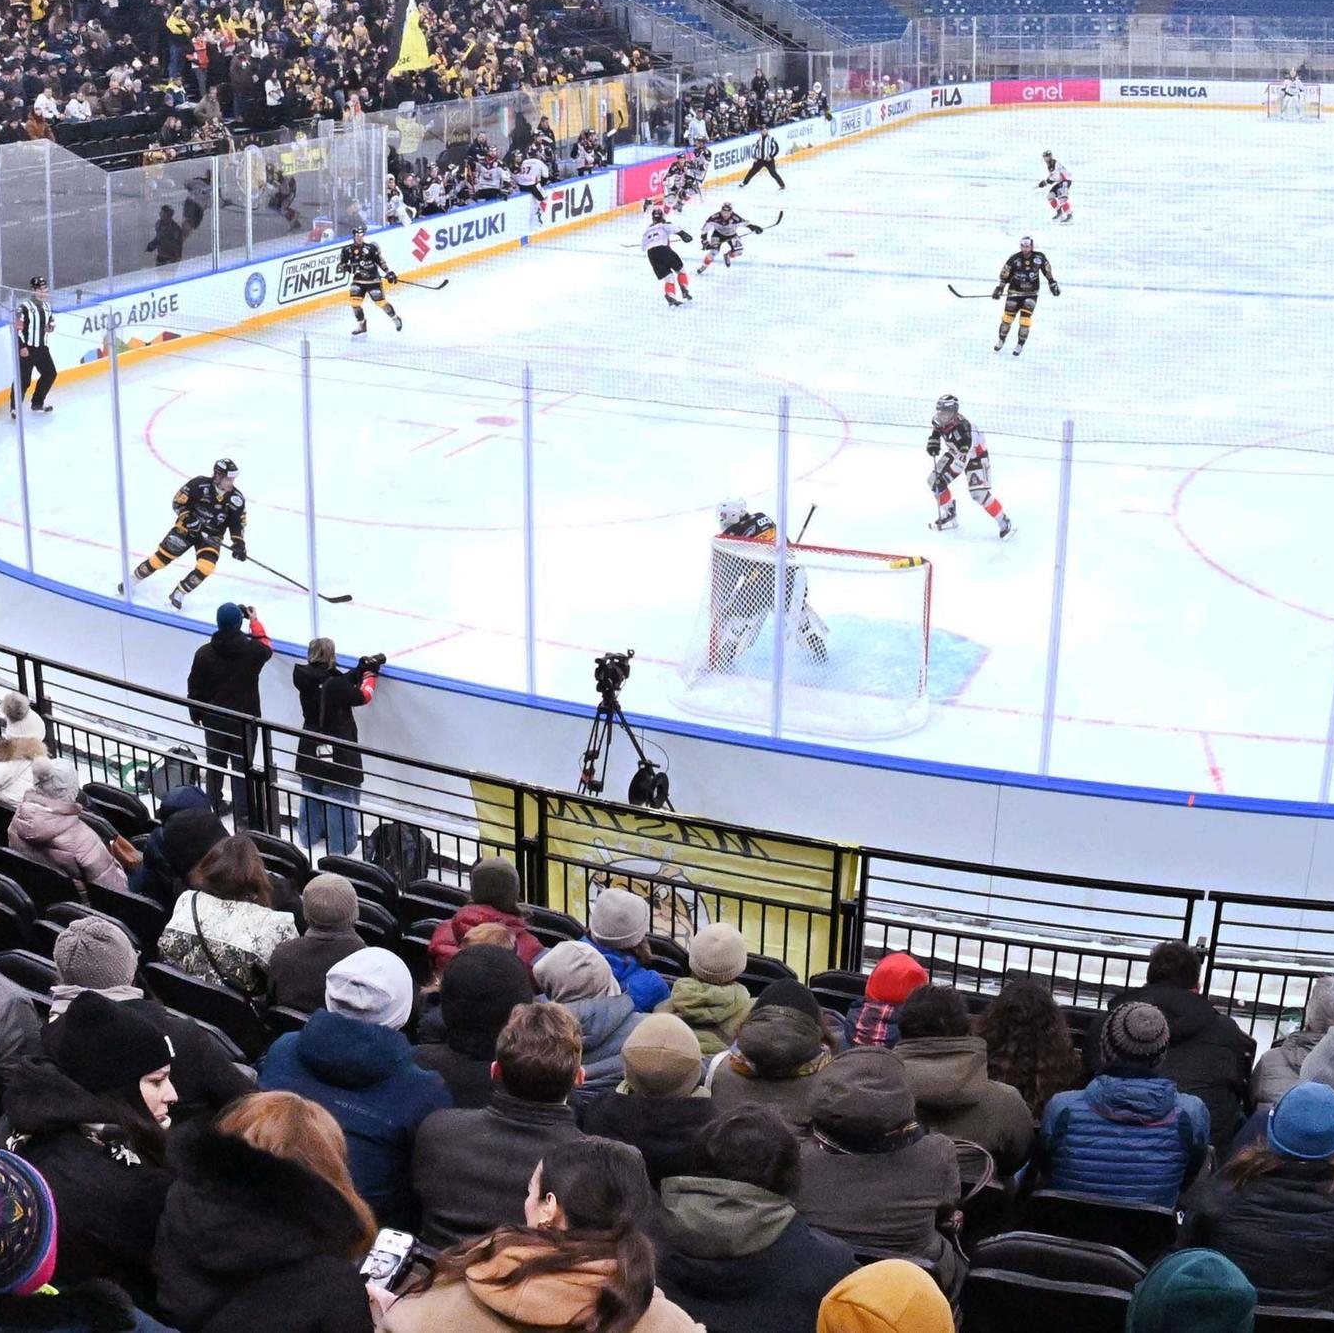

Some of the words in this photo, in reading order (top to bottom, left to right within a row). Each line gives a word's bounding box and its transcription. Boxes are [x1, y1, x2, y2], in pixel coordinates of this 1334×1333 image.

[931, 87, 962, 108] FILA
[1022, 82, 1064, 100] enel
[1120, 85, 1208, 98] ESSELUNGA
[888, 99, 912, 116] SUZUKI
[714, 139, 760, 170] ESSELUNG
[551, 183, 594, 223] FILA
[435, 212, 506, 251] SUZUKI
[286, 260, 317, 275] MILANO
[283, 266, 347, 297] FINALS
[127, 292, 179, 327] ADIGE
